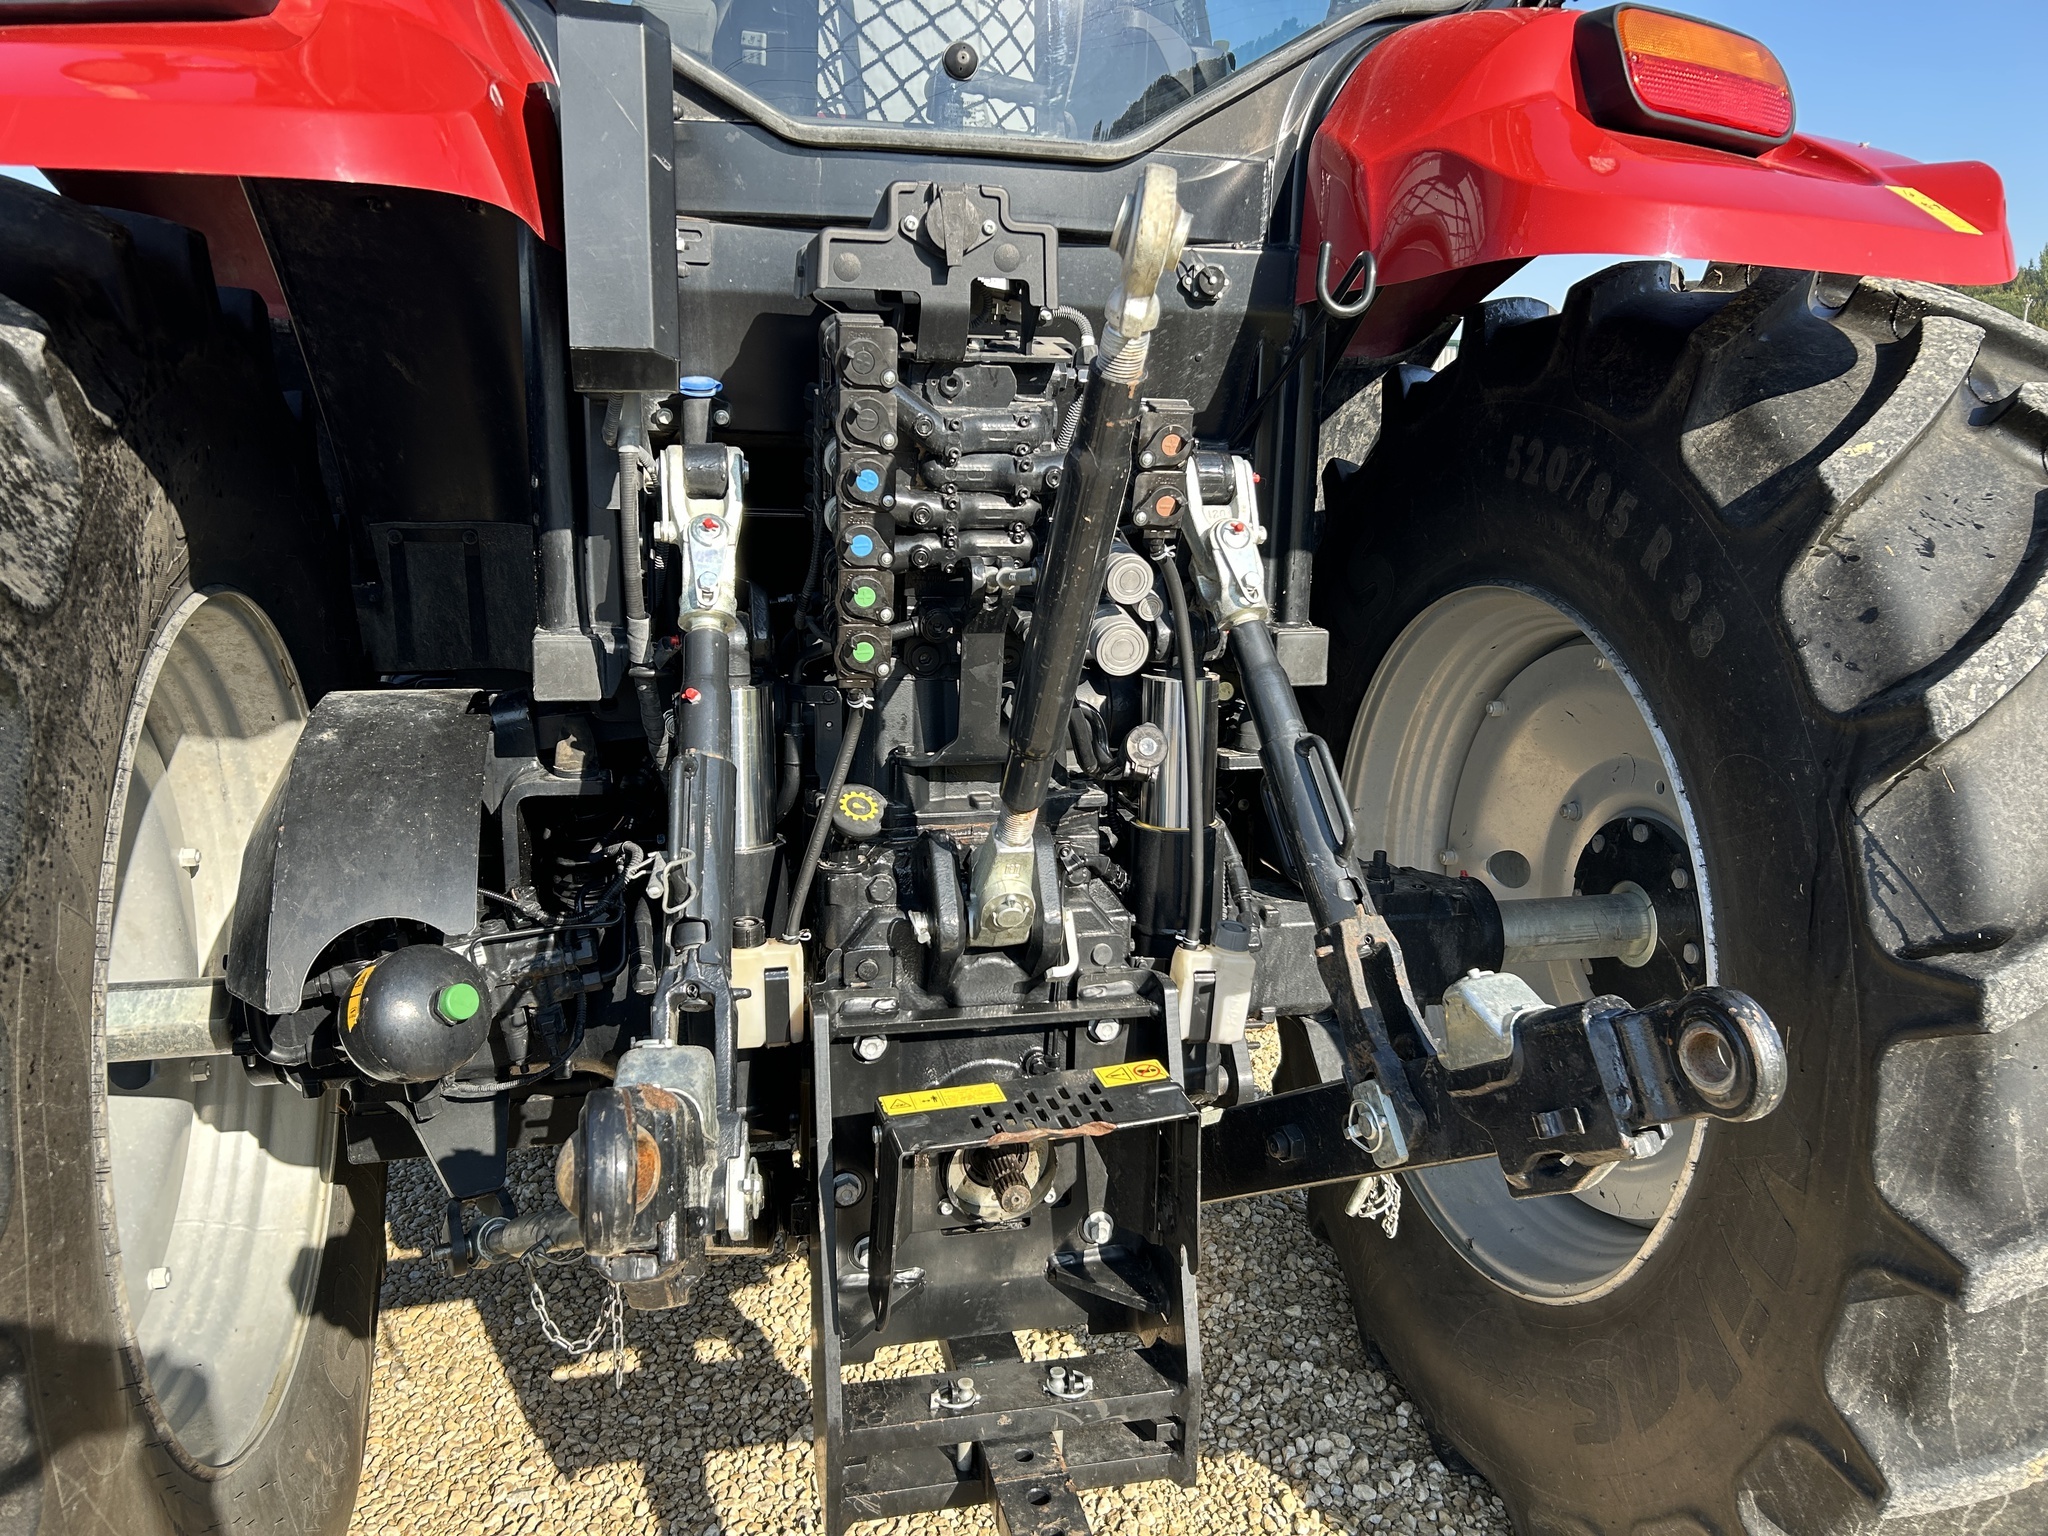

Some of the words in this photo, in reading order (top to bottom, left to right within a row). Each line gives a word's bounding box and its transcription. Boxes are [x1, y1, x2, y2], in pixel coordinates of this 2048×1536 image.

[1505, 435, 1638, 539] 520/85
[1640, 524, 1672, 581] R
[1671, 572, 1725, 658] 38
